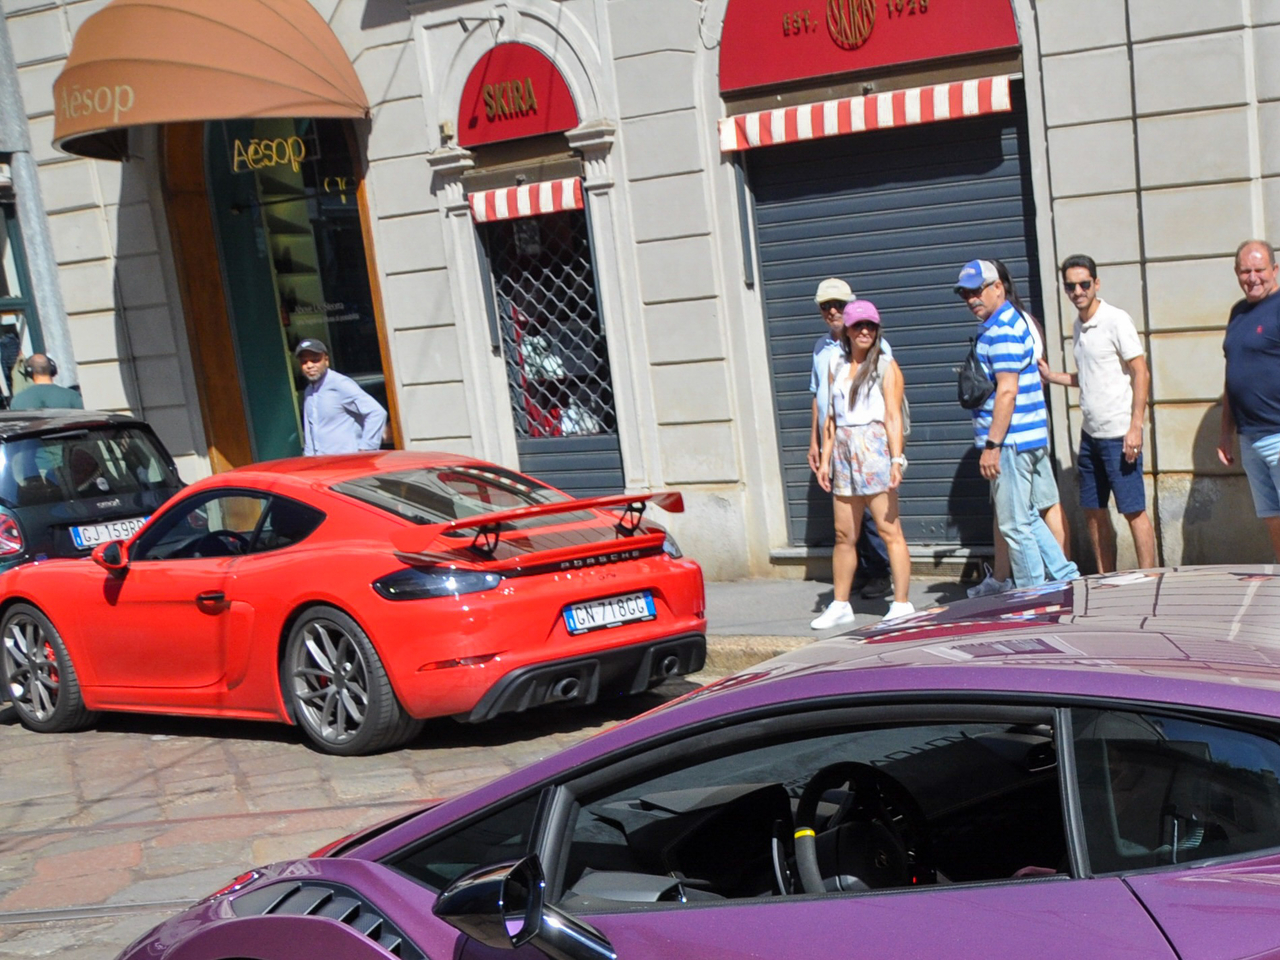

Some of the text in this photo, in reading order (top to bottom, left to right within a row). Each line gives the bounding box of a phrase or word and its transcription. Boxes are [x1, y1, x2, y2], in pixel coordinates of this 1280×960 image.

[783, 10, 818, 33] EST.
[483, 77, 537, 119] SKIRA
[560, 550, 640, 569] PORSCHE
[574, 595, 645, 626] GN 718GG
